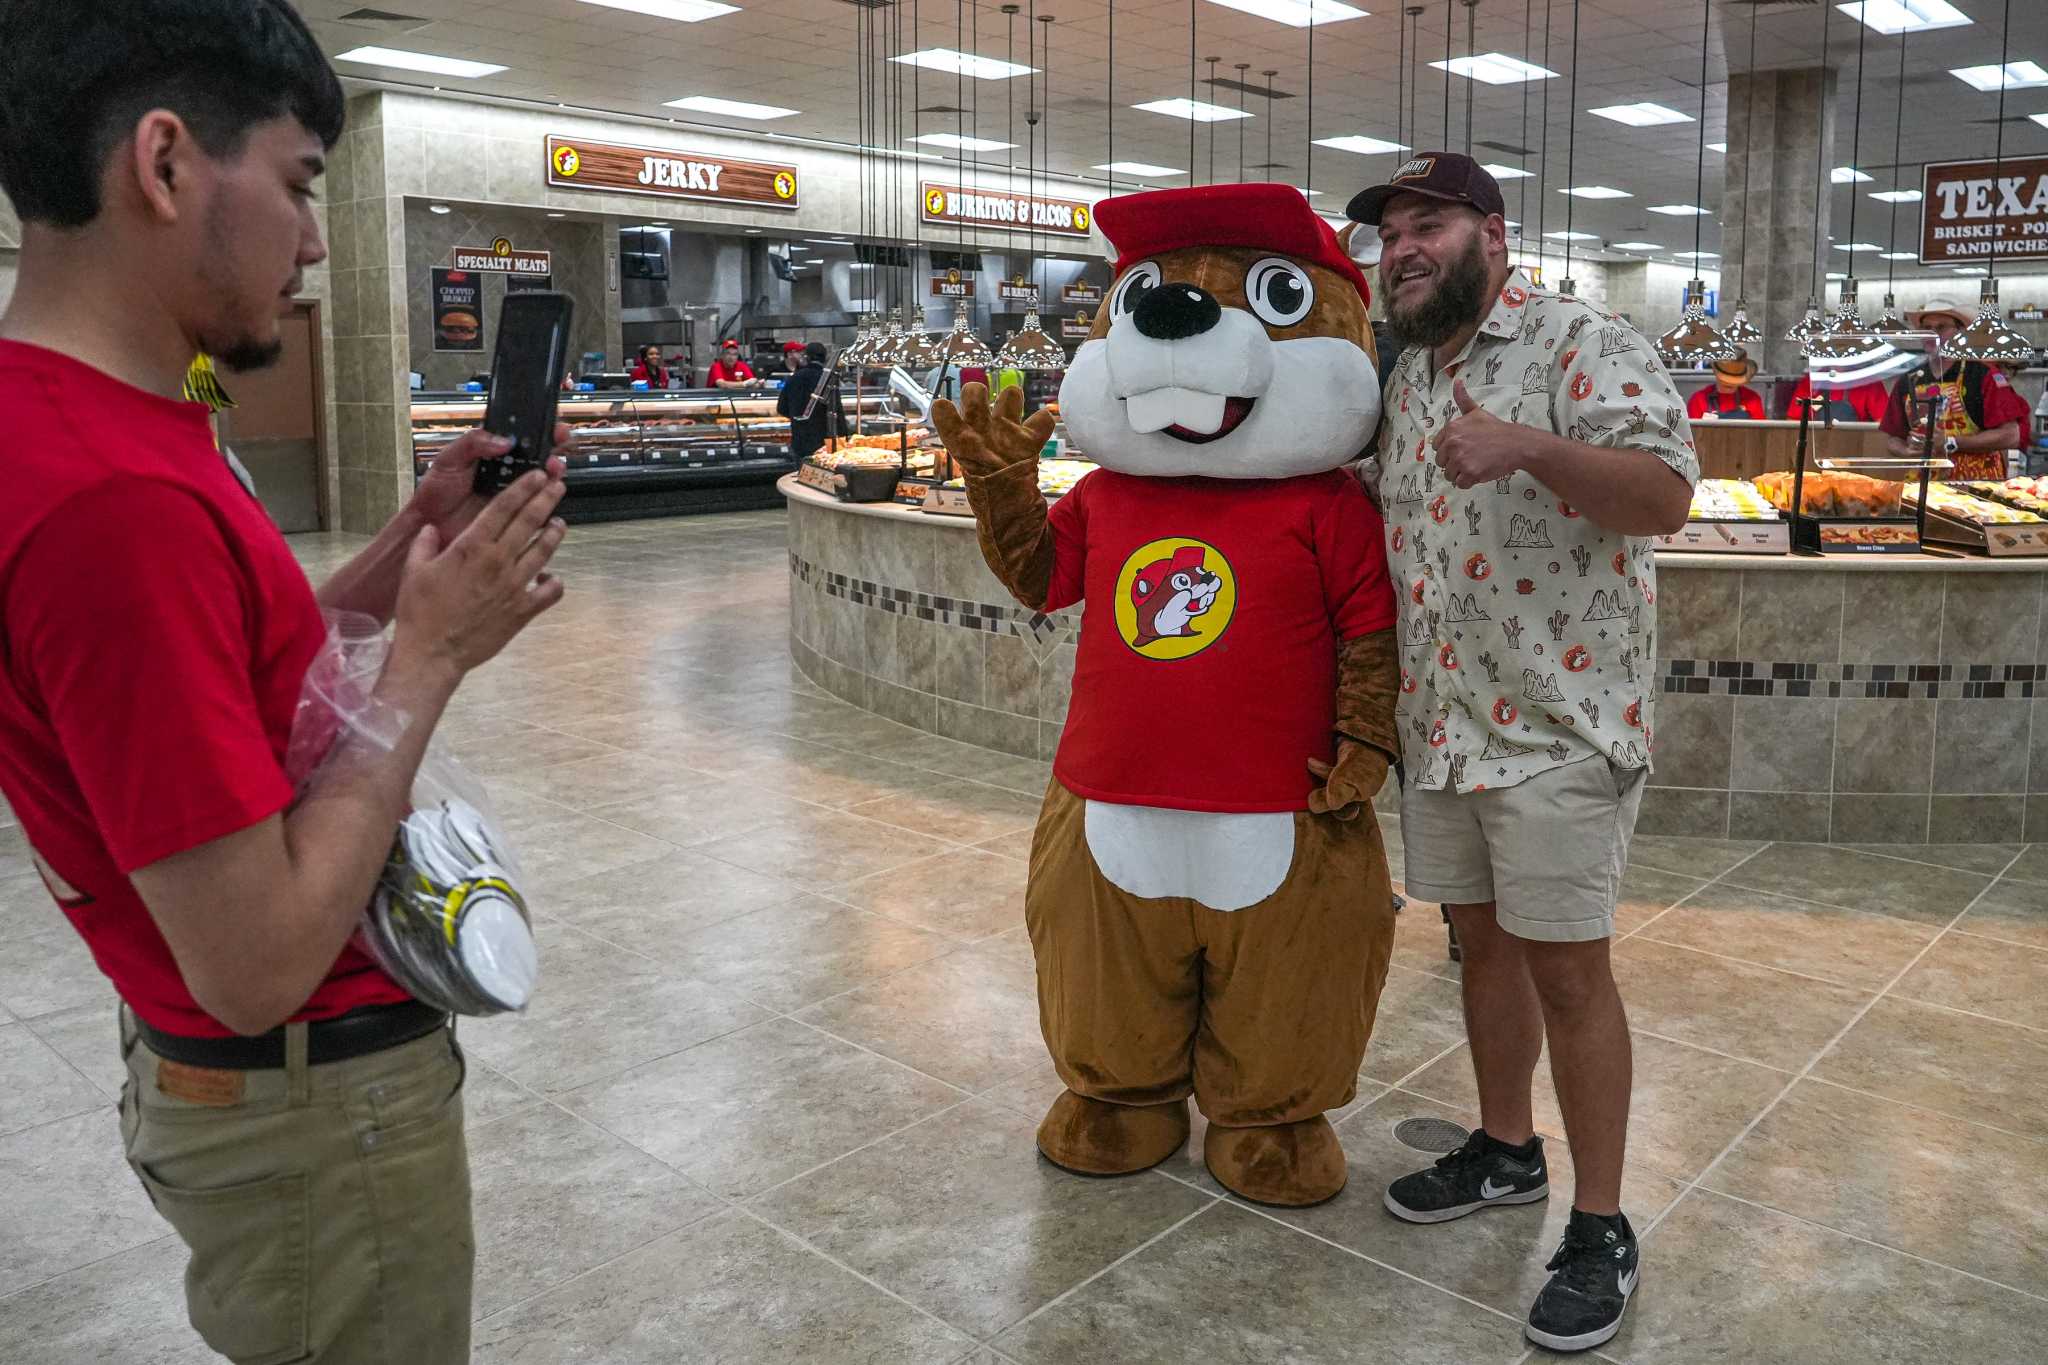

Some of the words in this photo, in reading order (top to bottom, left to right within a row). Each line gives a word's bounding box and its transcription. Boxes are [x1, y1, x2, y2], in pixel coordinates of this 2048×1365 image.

[638, 156, 723, 191] JERKY
[946, 191, 1016, 222] BURRITOS
[1017, 199, 1029, 223] &
[1032, 202, 1072, 228] TACOS
[1934, 224, 2006, 239] BRISKET
[457, 255, 513, 270] SPECIALTY
[514, 258, 548, 272] MEATS
[940, 283, 966, 295] TACOS
